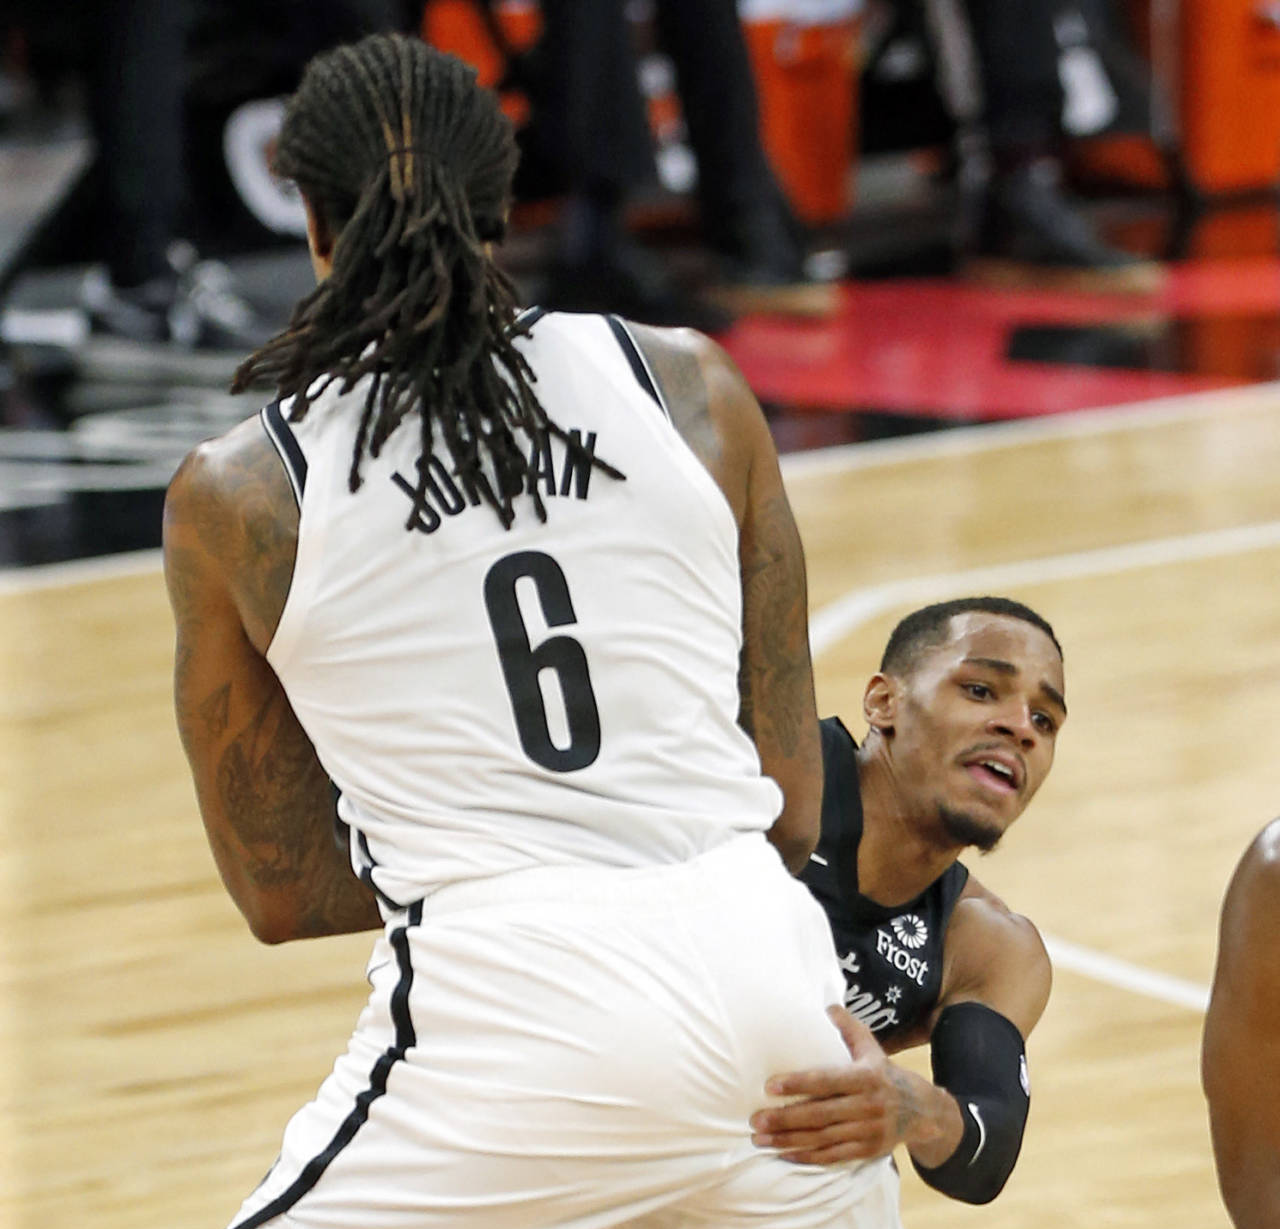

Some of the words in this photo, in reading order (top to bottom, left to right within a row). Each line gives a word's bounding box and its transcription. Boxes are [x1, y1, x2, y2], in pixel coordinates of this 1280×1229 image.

[390, 428, 598, 534] JOAN
[483, 550, 601, 773] 6
[876, 928, 930, 986] Frost
